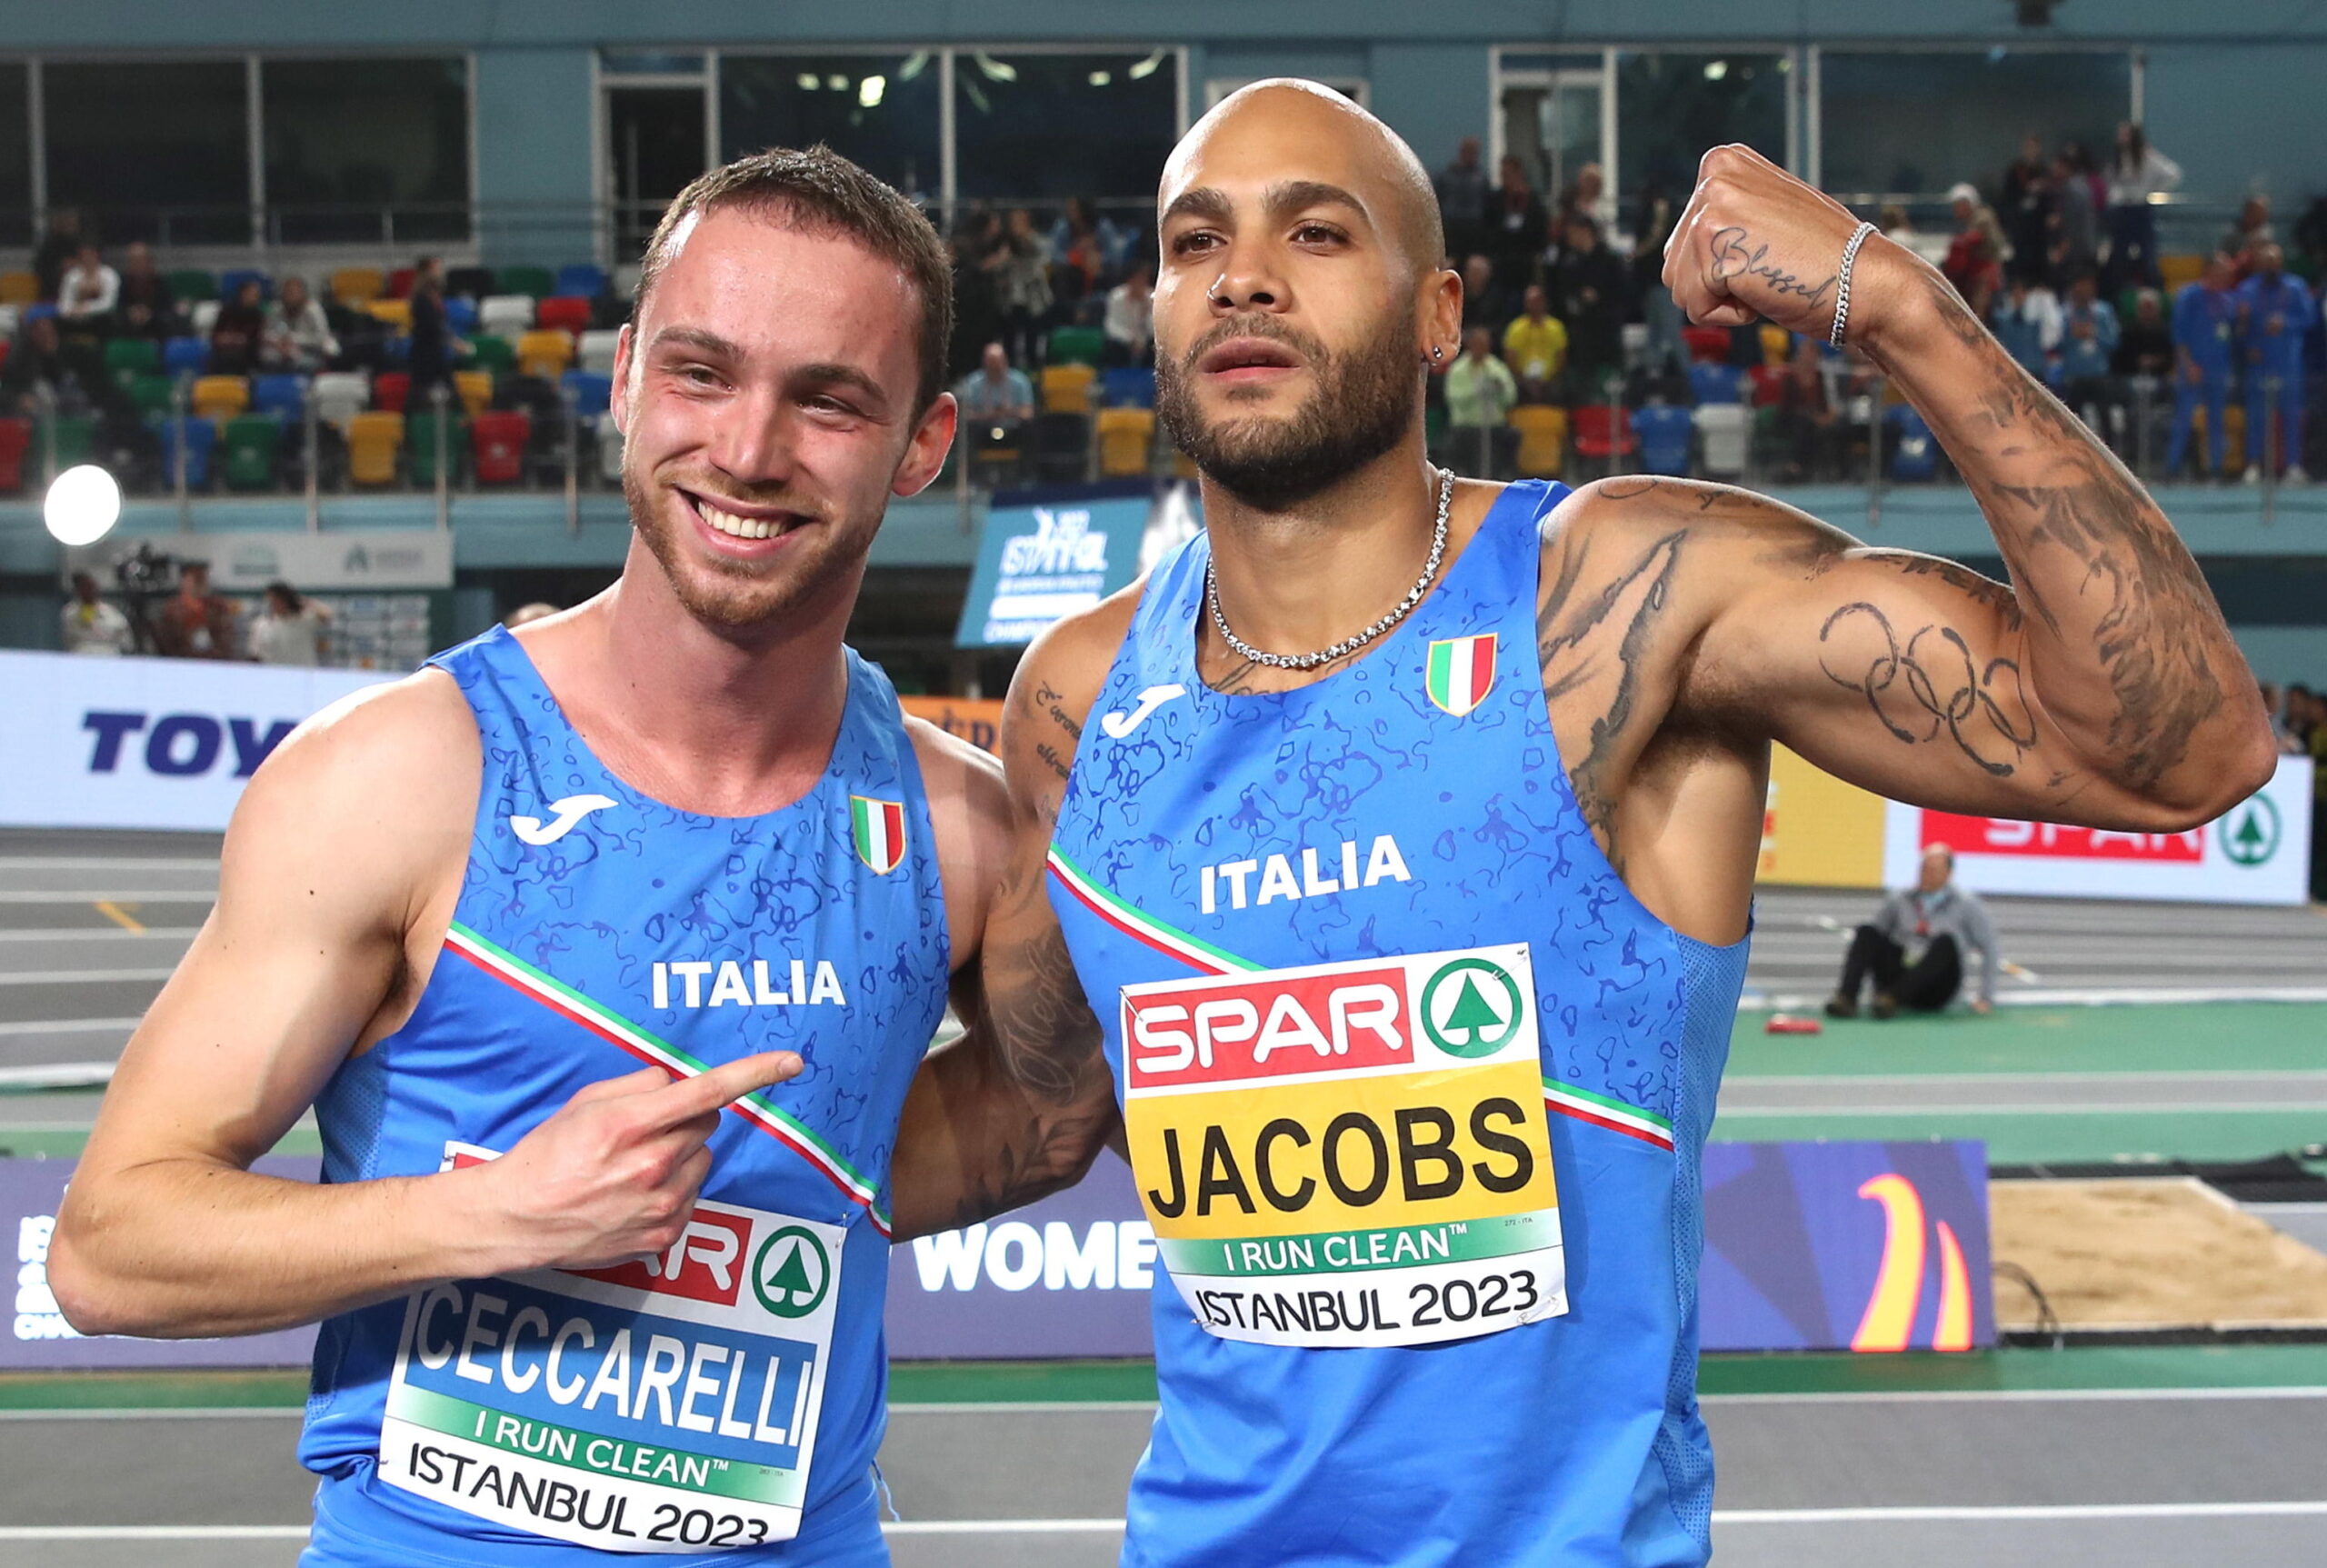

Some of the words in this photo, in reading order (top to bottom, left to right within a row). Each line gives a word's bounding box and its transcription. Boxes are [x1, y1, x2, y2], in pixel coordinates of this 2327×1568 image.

[1711, 226, 1838, 309] Blessed
[83, 712, 302, 778] TOY
[1201, 834, 1413, 914] ITALIA
[653, 959, 847, 1009] ITALIA
[1134, 983, 1404, 1074] SPAR
[1148, 1096, 1534, 1219] JACOBS
[912, 1220, 1158, 1292] WOME
[1223, 1243, 1235, 1272] I
[1241, 1238, 1315, 1271] RUN
[1195, 1287, 1401, 1332] ISTANBUL
[1409, 1270, 1538, 1327] 2023
[416, 1283, 813, 1447] CECCARELLI
[474, 1410, 487, 1438] I
[494, 1415, 577, 1461] RUN
[409, 1442, 637, 1538] ISTANBUL
[647, 1503, 770, 1547] 2023
